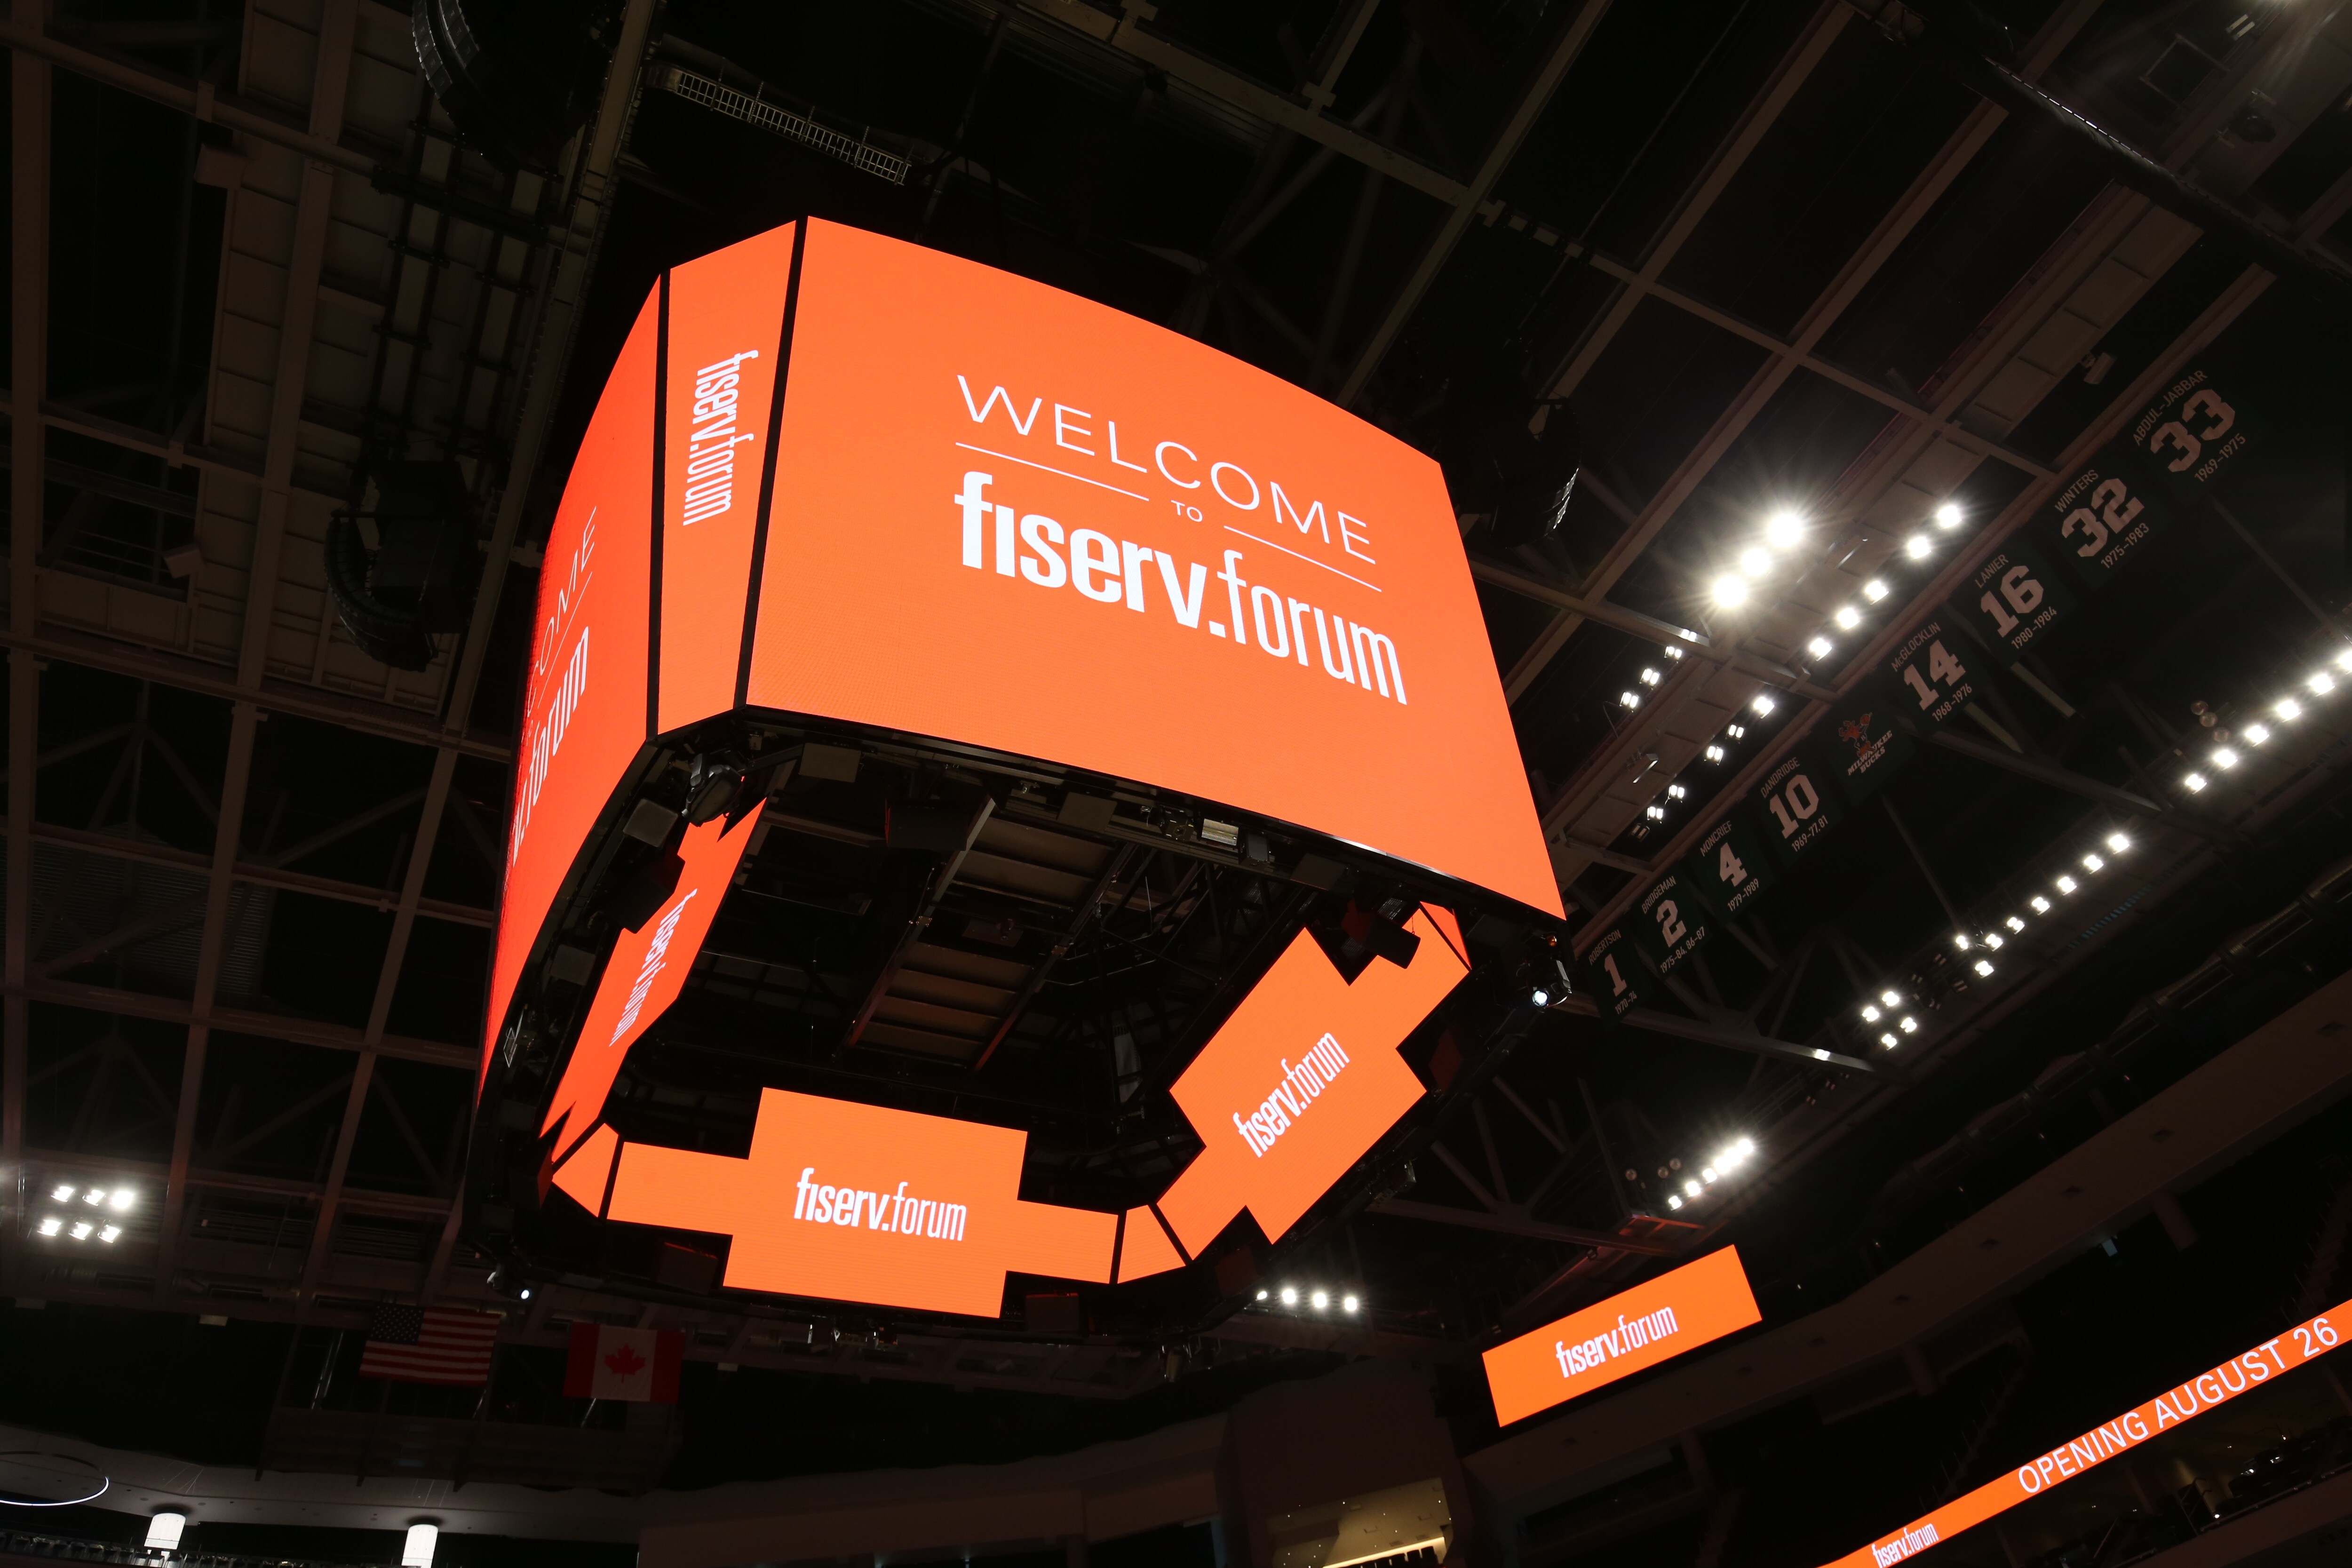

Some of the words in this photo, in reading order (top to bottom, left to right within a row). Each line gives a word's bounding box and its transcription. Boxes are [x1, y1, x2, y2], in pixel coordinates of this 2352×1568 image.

[2132, 370, 2208, 446] ABDUL-JABBAR
[2150, 389, 2235, 472] 33
[683, 350, 759, 526] fiserv.forum
[2194, 433, 2246, 482] 1969-1975
[957, 374, 1376, 565] WELCOME
[2055, 470, 2099, 513] WINTERS
[1170, 500, 1203, 522] TO
[2061, 478, 2145, 557] 32
[2101, 523, 2149, 569] 1975-1983
[954, 471, 1407, 705] fiserv.forum
[1975, 554, 2009, 588] LANIER
[524, 506, 596, 724] COME
[1980, 565, 2044, 638] 16
[1891, 621, 1942, 672] McGLOCKLIN
[2011, 606, 2058, 650] 1980-1984
[1904, 639, 1966, 711] 14
[1931, 683, 1972, 722] 1968-1976
[1761, 757, 1800, 798] DANDRIDGE
[1859, 746, 1885, 773] BUCKS
[1769, 774, 1820, 839] 10
[1700, 820, 1732, 857] MONCRIEF
[1719, 842, 1748, 887] 4
[1641, 876, 1677, 915] BRIDGEMAN
[1727, 878, 1759, 912] 1979-1989
[1588, 929, 1621, 965] ROBERTSON
[1656, 899, 1687, 948] 2
[1686, 926, 1705, 950] 86-87
[1604, 953, 1628, 997] 1
[1615, 990, 1637, 1015] 1970-74
[1232, 1032, 1350, 1158] fiserv.forum
[794, 1167, 967, 1241] fiserv.forum
[1556, 1307, 1678, 1378] fiserv.forum
[1871, 1523, 1939, 1568] fiserv.forum
[2018, 1412, 2149, 1493] OPENING
[2155, 1339, 2285, 1429] AUGUST
[2293, 1318, 2338, 1357] 26
